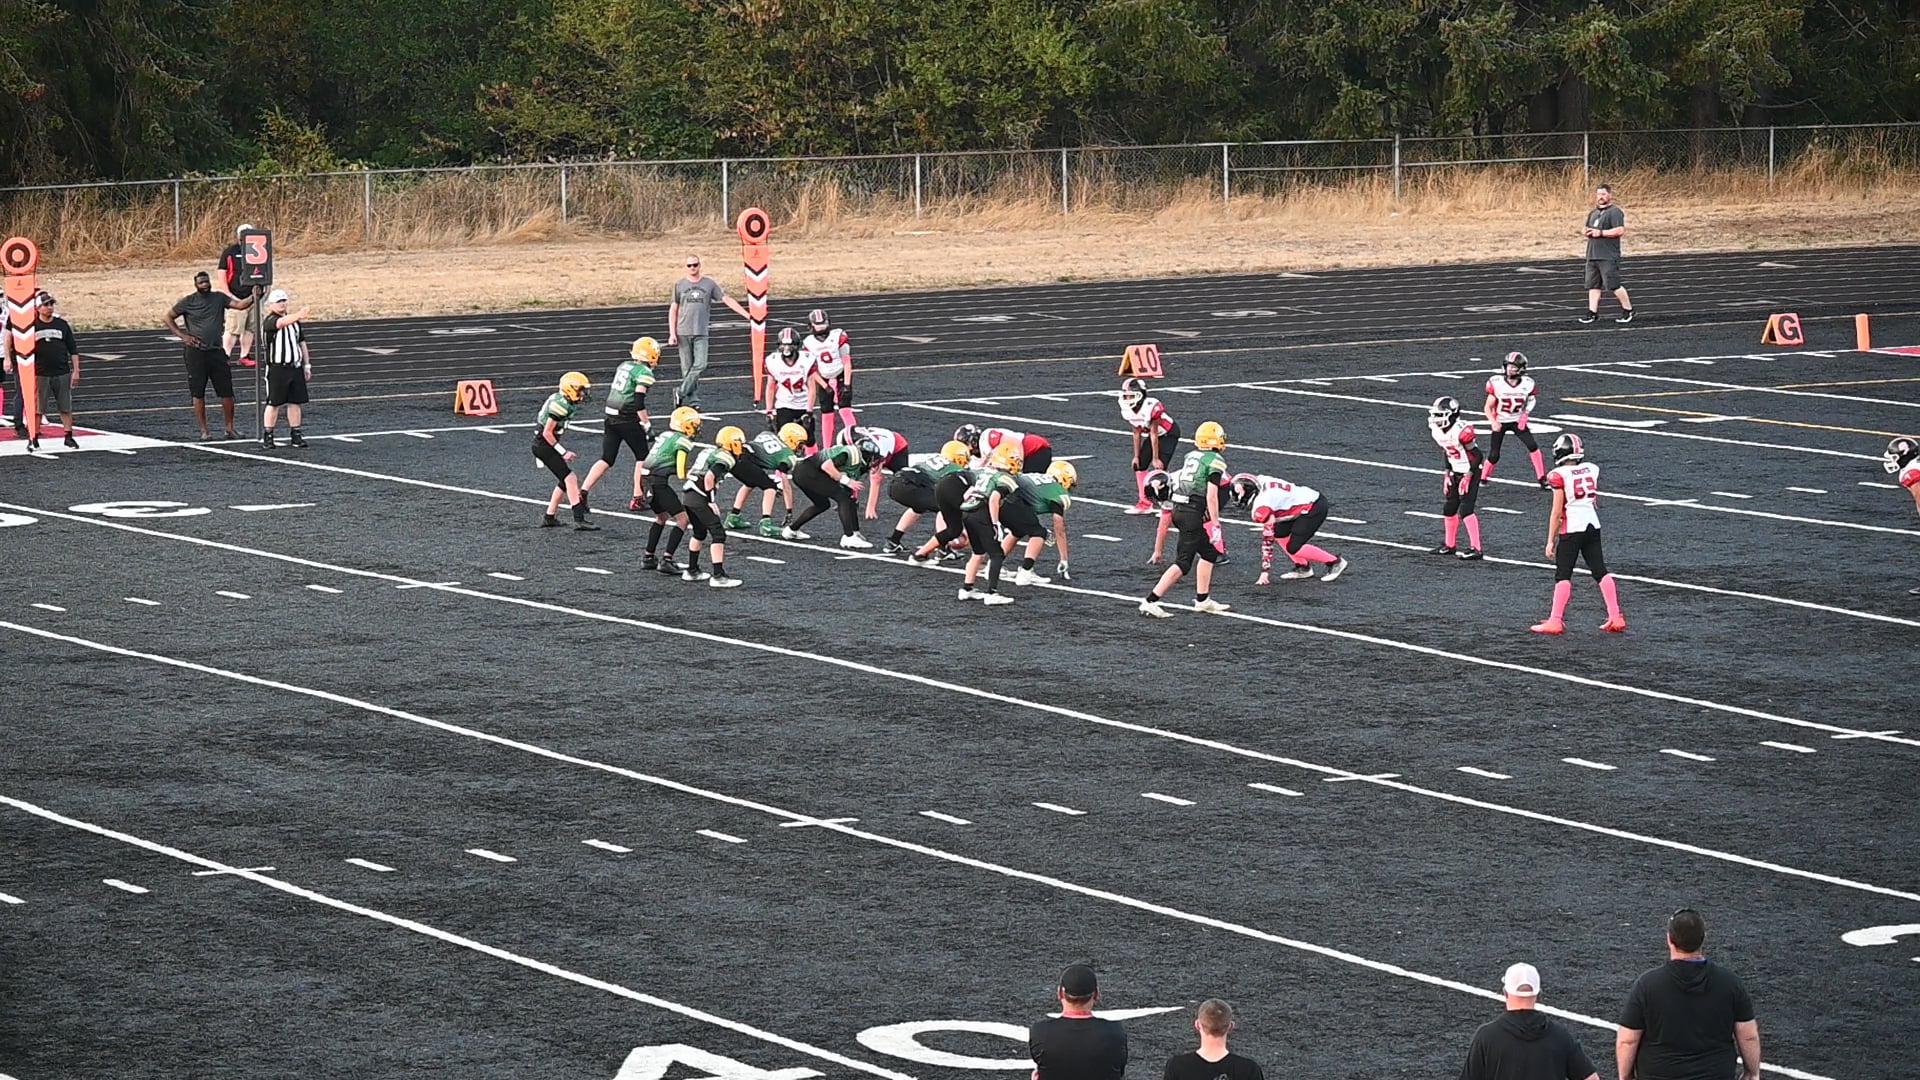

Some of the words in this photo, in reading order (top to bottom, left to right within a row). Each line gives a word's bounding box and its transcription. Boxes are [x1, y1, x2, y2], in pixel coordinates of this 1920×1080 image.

[245, 234, 268, 265] 3
[1777, 314, 1801, 341] G
[1134, 346, 1159, 373] 10
[464, 383, 492, 410] 20
[1500, 397, 1526, 415] 22
